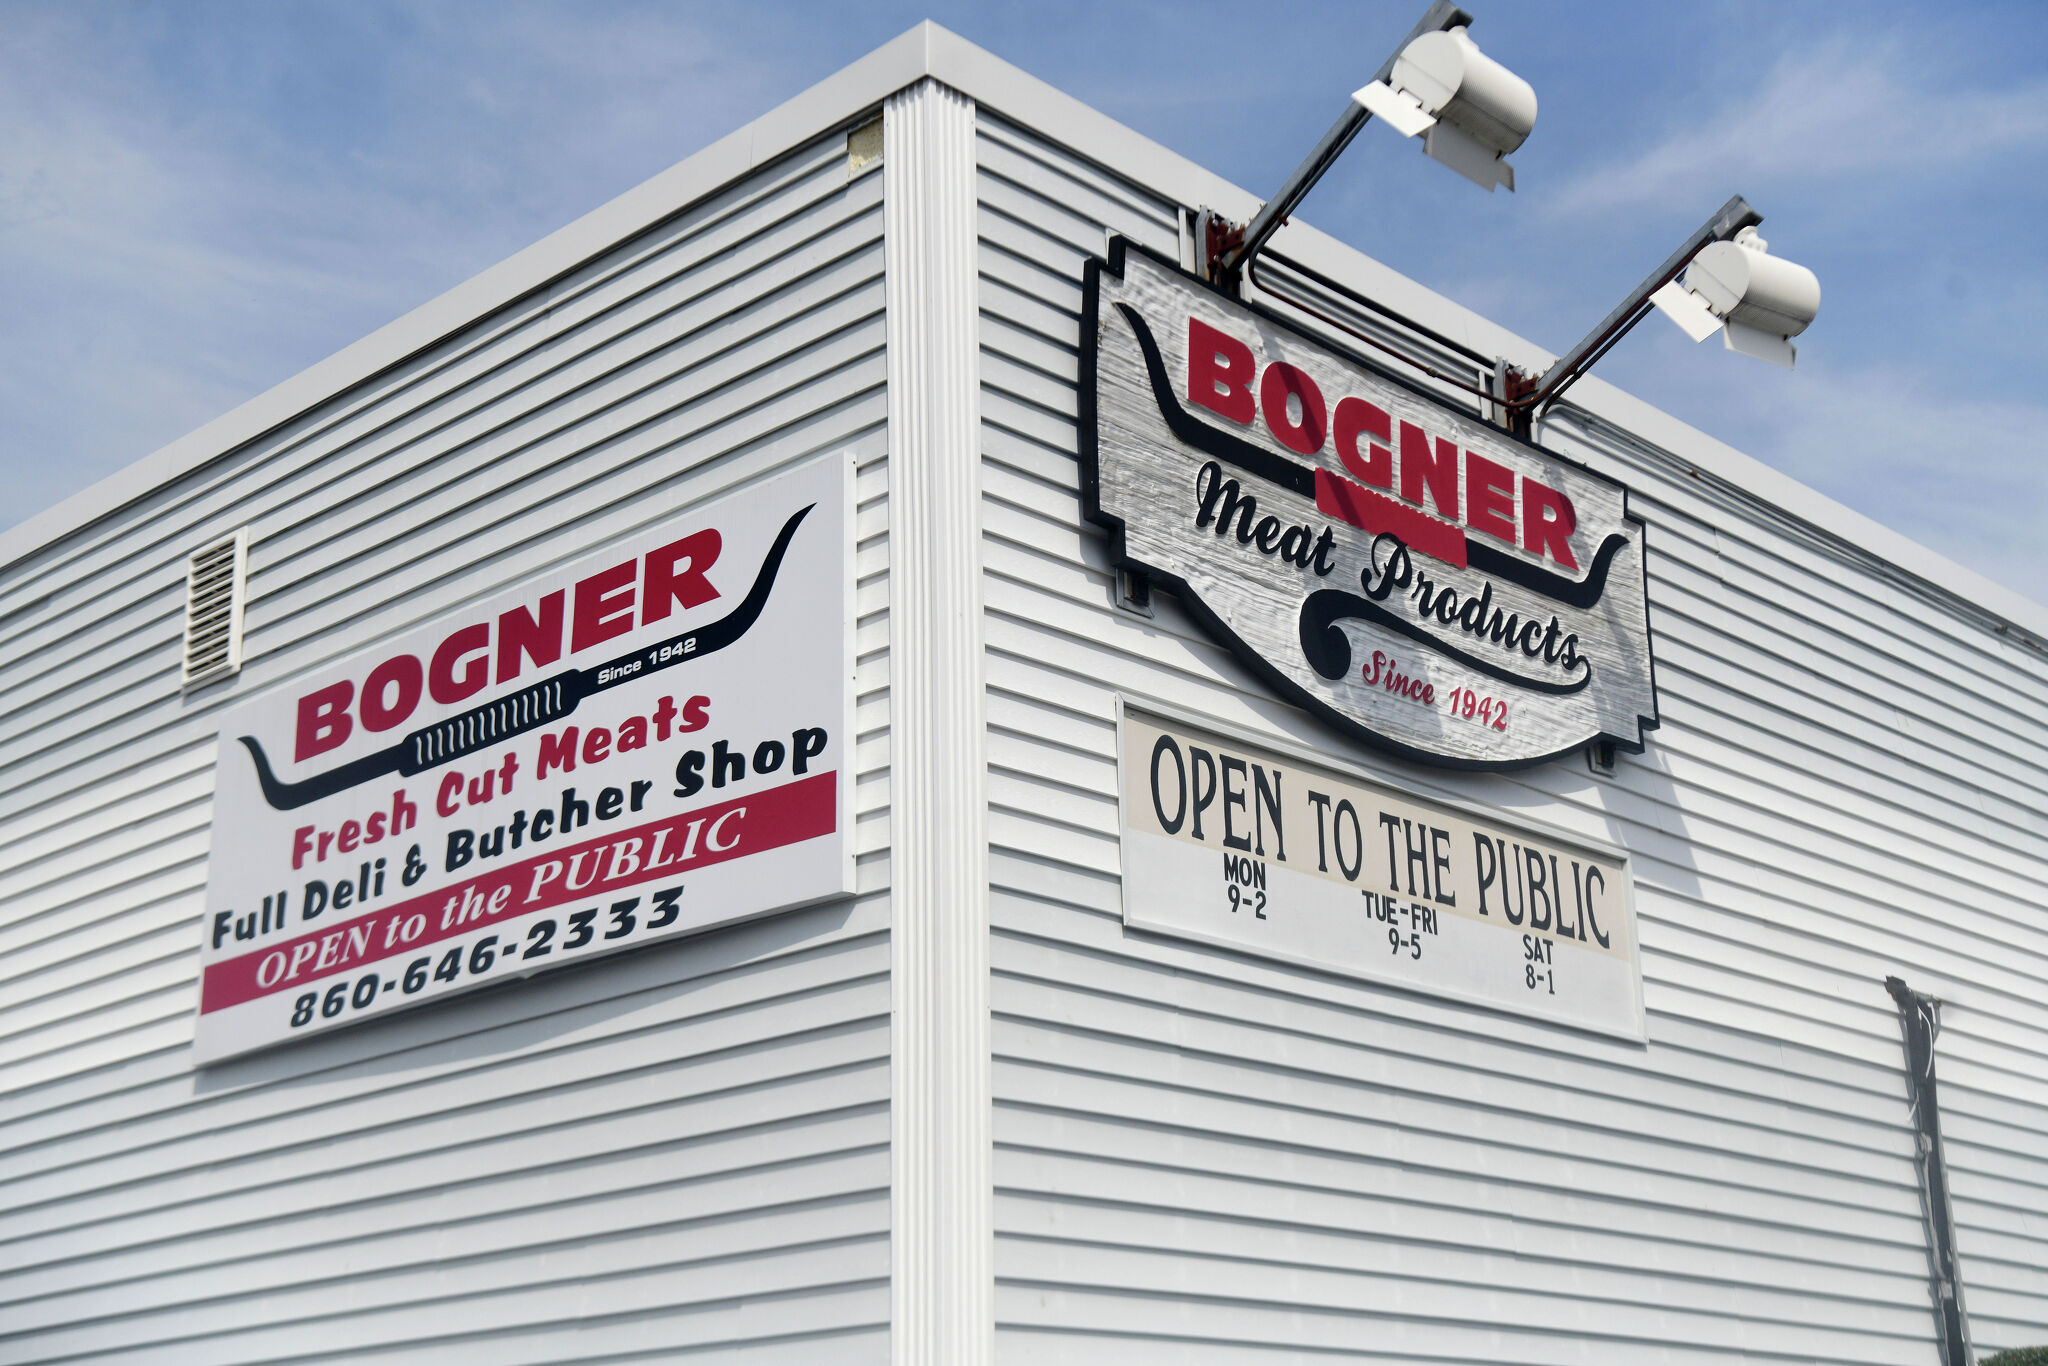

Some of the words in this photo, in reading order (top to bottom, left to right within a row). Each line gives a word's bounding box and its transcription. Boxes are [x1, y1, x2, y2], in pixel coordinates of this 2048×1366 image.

[1188, 316, 1578, 571] BOGNER
[1195, 461, 1337, 576] Meat
[1361, 532, 1588, 674] Products
[294, 528, 722, 763] BOGNER
[597, 657, 643, 686] Since
[648, 637, 696, 666] 1942
[1362, 650, 1435, 704] Since
[1450, 685, 1508, 731] 1942
[291, 789, 417, 870] Fresh
[436, 752, 518, 818] Cut
[537, 695, 711, 782] Meats
[212, 891, 286, 950] Full
[301, 857, 386, 922] Deli
[401, 844, 427, 888] &
[446, 777, 652, 873] Butcher
[673, 727, 828, 798] Shop
[1150, 735, 1286, 861] OPEN
[1308, 790, 1362, 882] TO
[1380, 812, 1456, 907] THE
[1473, 832, 1610, 949] PUBLIC
[1224, 853, 1266, 892] MON
[255, 920, 377, 989] OPEN
[383, 914, 425, 951] to
[441, 884, 510, 923] the
[522, 807, 746, 904] PUBLIC
[1227, 883, 1267, 920] 9-2
[1362, 890, 1438, 936] TUE-FRI
[1389, 934, 1421, 960] 9-5
[1523, 935, 1553, 965] SAT
[290, 886, 684, 1028] 860-646-2333
[1525, 963, 1554, 995] 8-1
